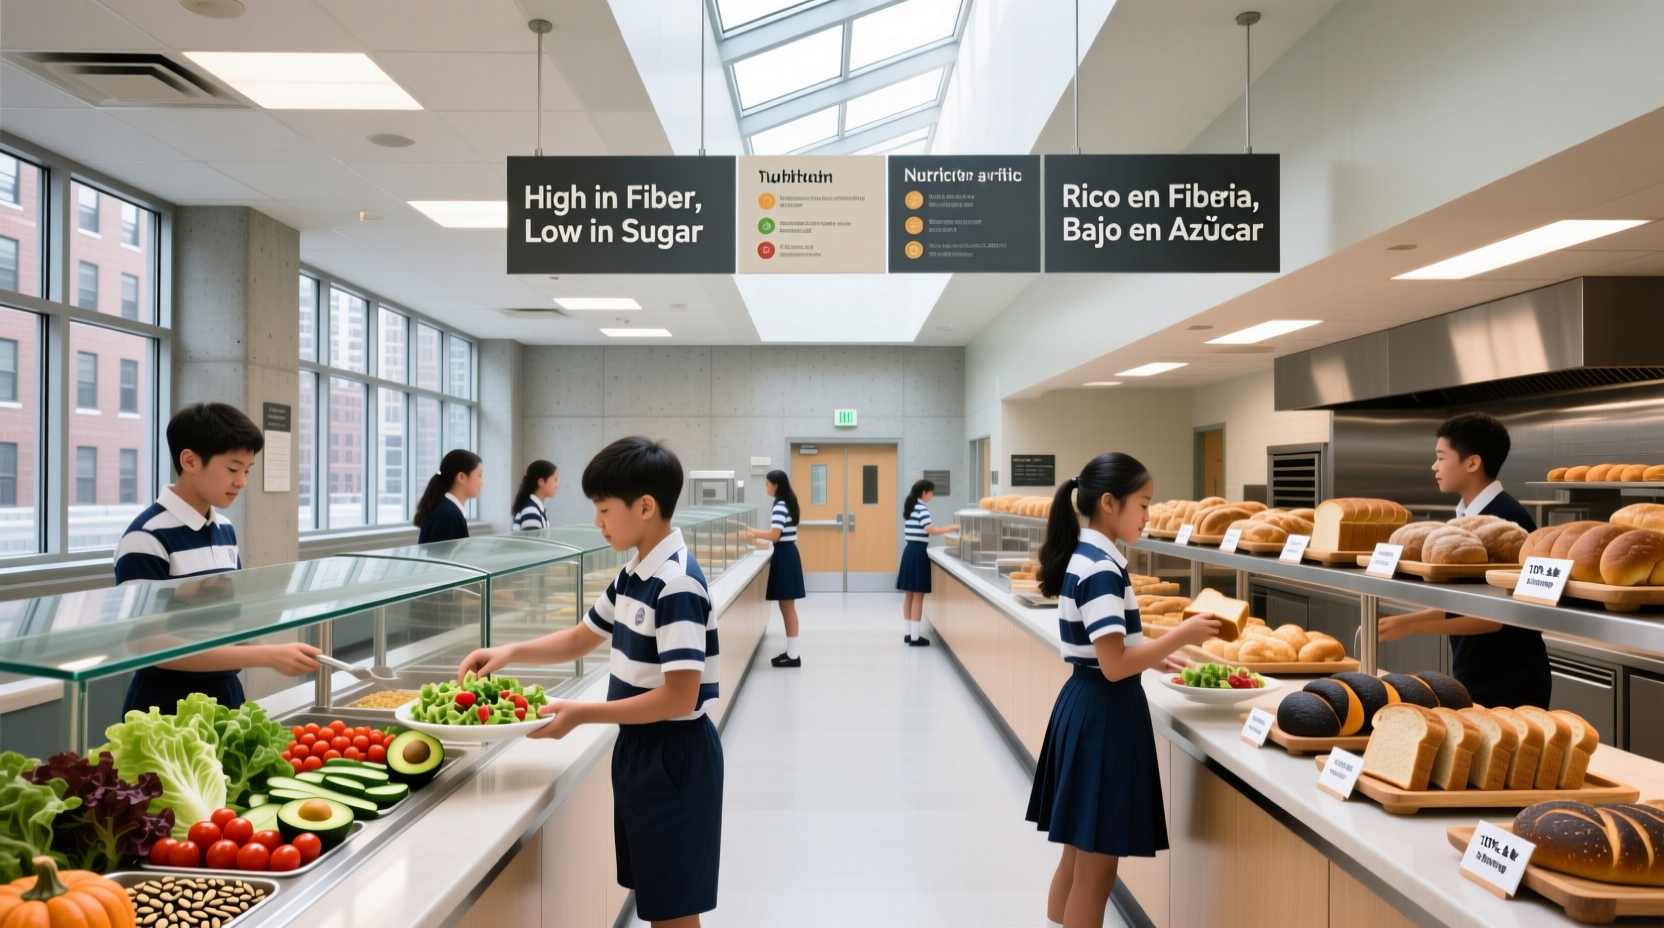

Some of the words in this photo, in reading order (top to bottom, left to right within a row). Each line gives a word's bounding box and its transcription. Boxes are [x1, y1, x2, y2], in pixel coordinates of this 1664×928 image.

[524, 184, 587, 216] High
[595, 184, 618, 209] in
[627, 183, 702, 214] Fiber,
[1063, 183, 1121, 208] Rico
[1128, 190, 1160, 208] en
[525, 218, 583, 243] Low
[590, 218, 614, 243] in
[621, 218, 704, 250] Sugar
[1063, 215, 1122, 249] Bajo
[1129, 222, 1162, 241] en
